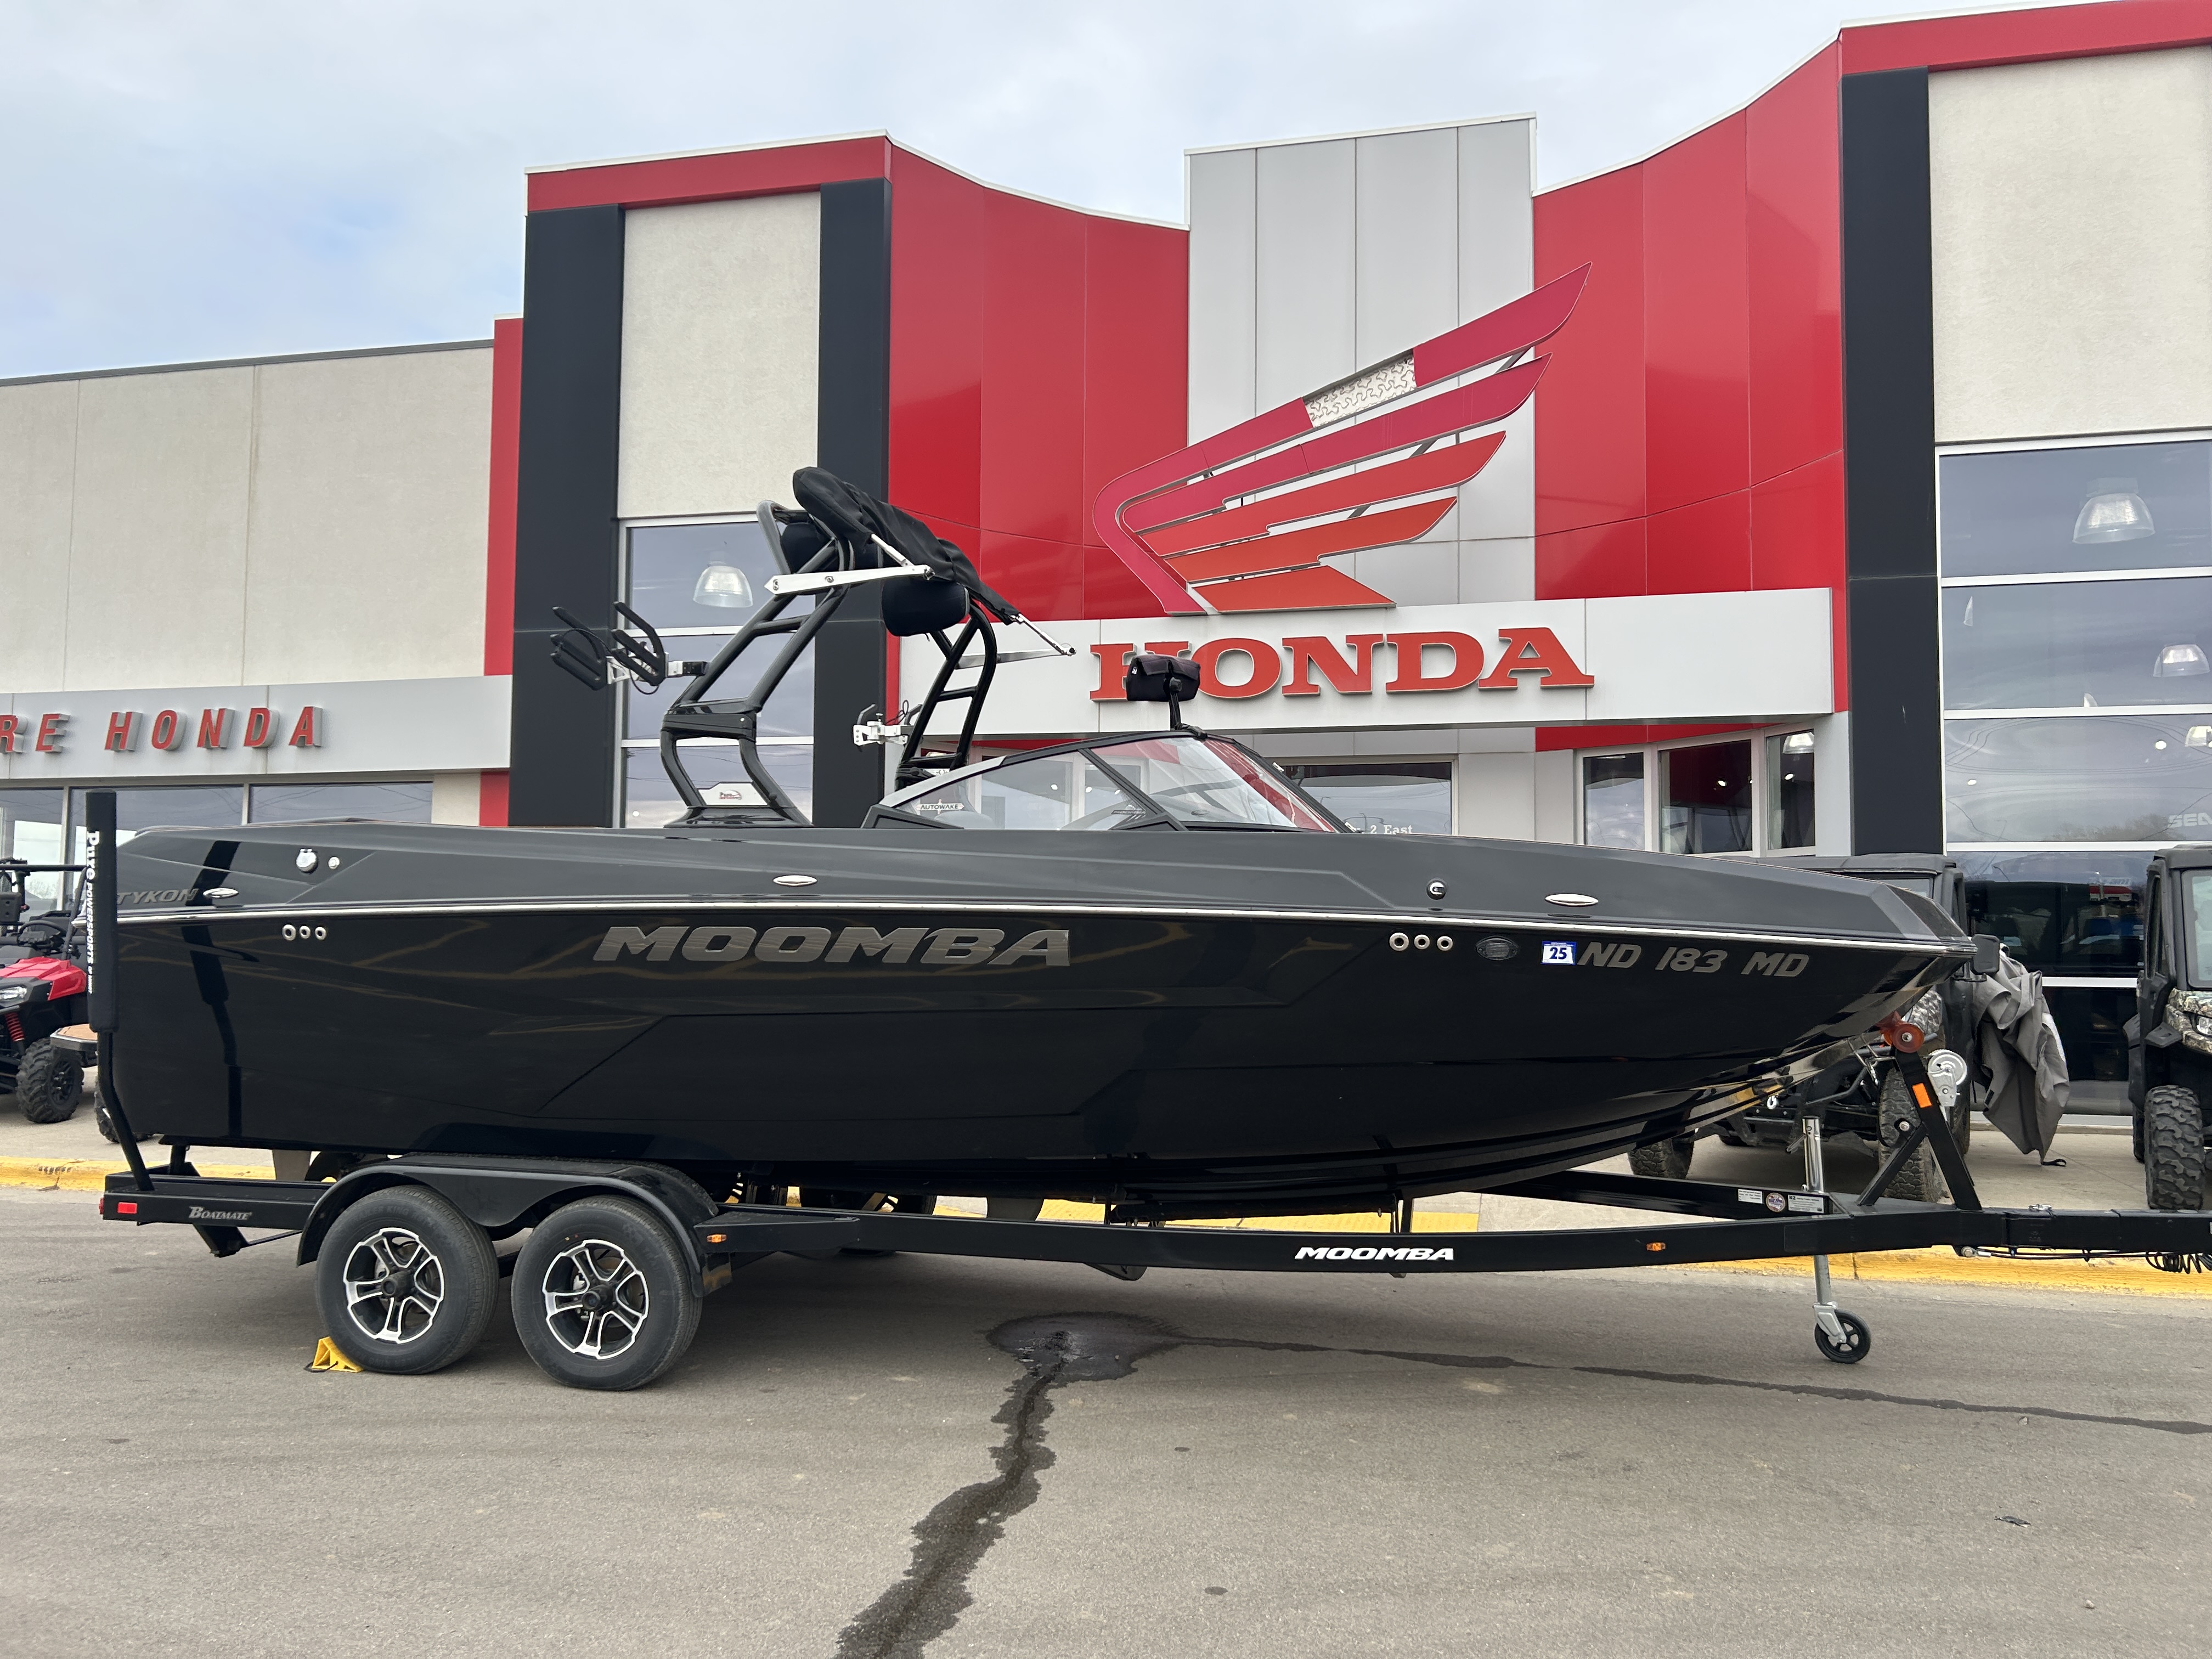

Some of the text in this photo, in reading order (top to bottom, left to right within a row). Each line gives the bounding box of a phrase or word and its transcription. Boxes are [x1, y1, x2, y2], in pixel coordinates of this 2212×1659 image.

[1090, 627, 1594, 701] HONDA
[0, 706, 323, 753] RE HONDA
[1370, 825, 1377, 834] 2
[1383, 825, 1413, 834] East
[86, 831, 100, 880] Pure
[117, 888, 199, 905] TYKON
[592, 926, 1070, 966] MOOMBA
[1549, 947, 1567, 960] 25
[1577, 942, 1809, 977] ND 183 MD
[1294, 1247, 1454, 1260] MOOMBA
